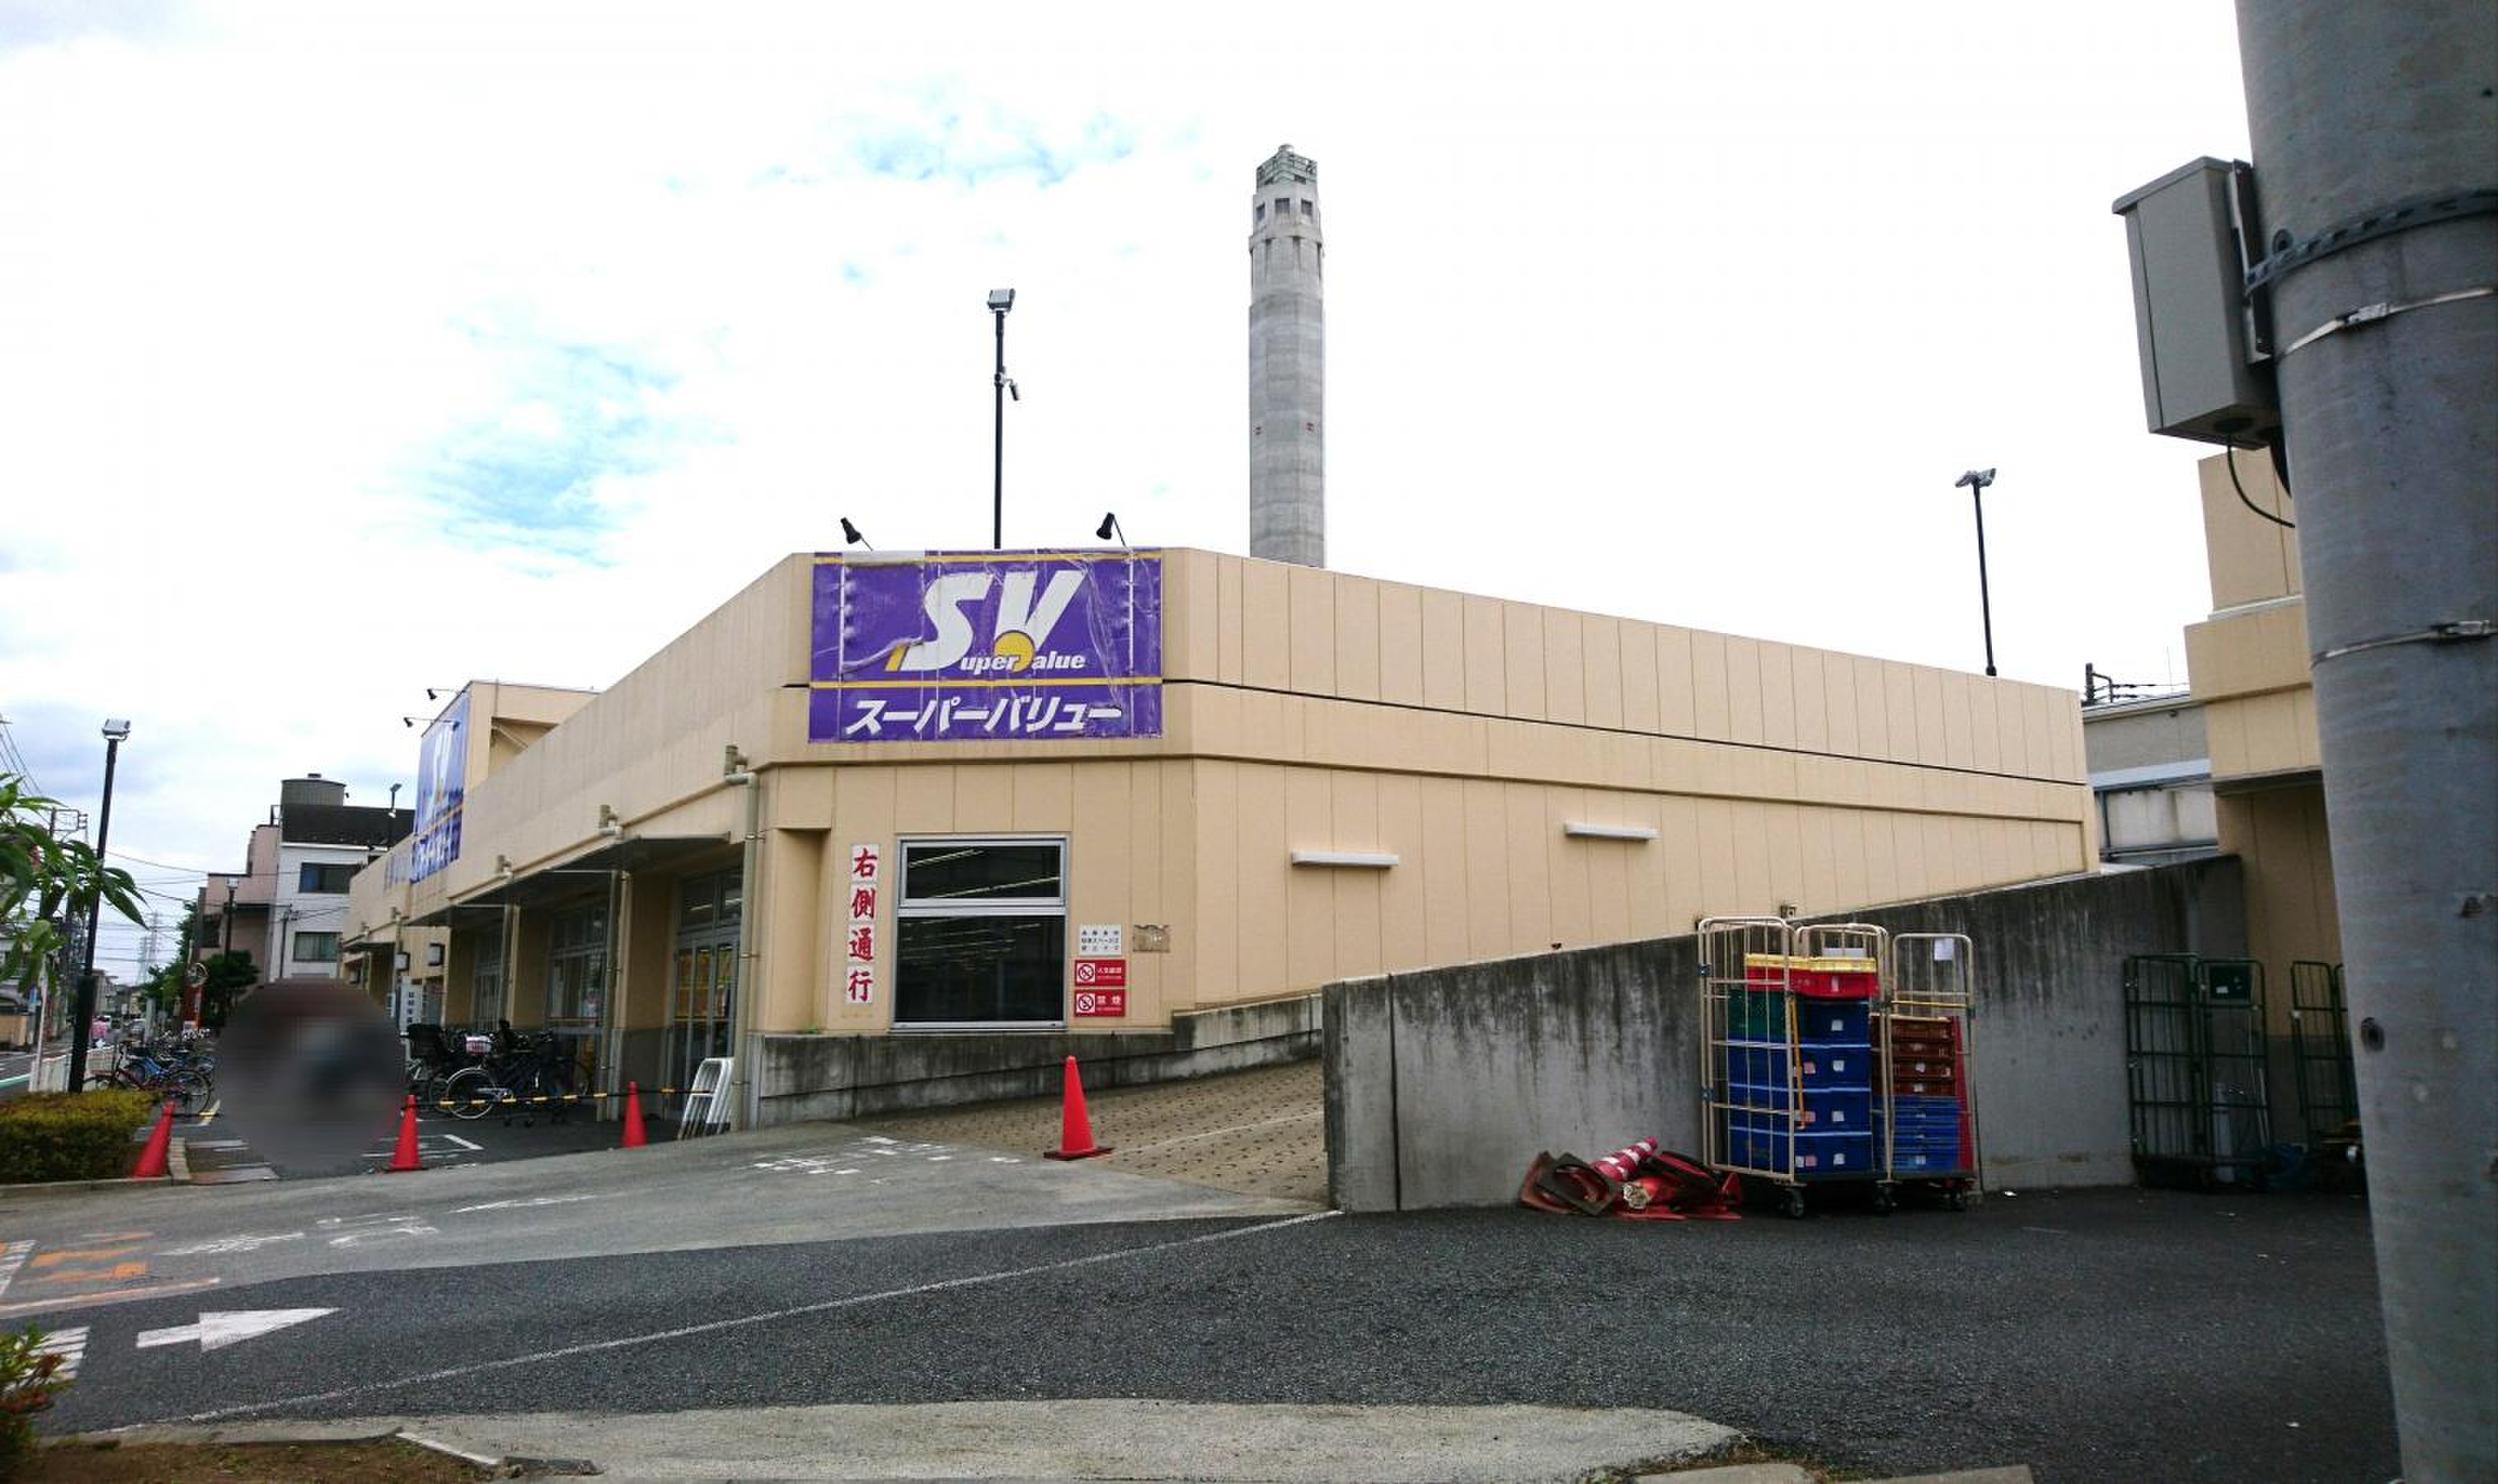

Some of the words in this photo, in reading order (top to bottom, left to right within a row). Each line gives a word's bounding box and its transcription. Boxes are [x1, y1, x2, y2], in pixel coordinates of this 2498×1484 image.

[845, 696, 1122, 735] スーパーバリュー
[848, 847, 878, 1003] 右側通行
